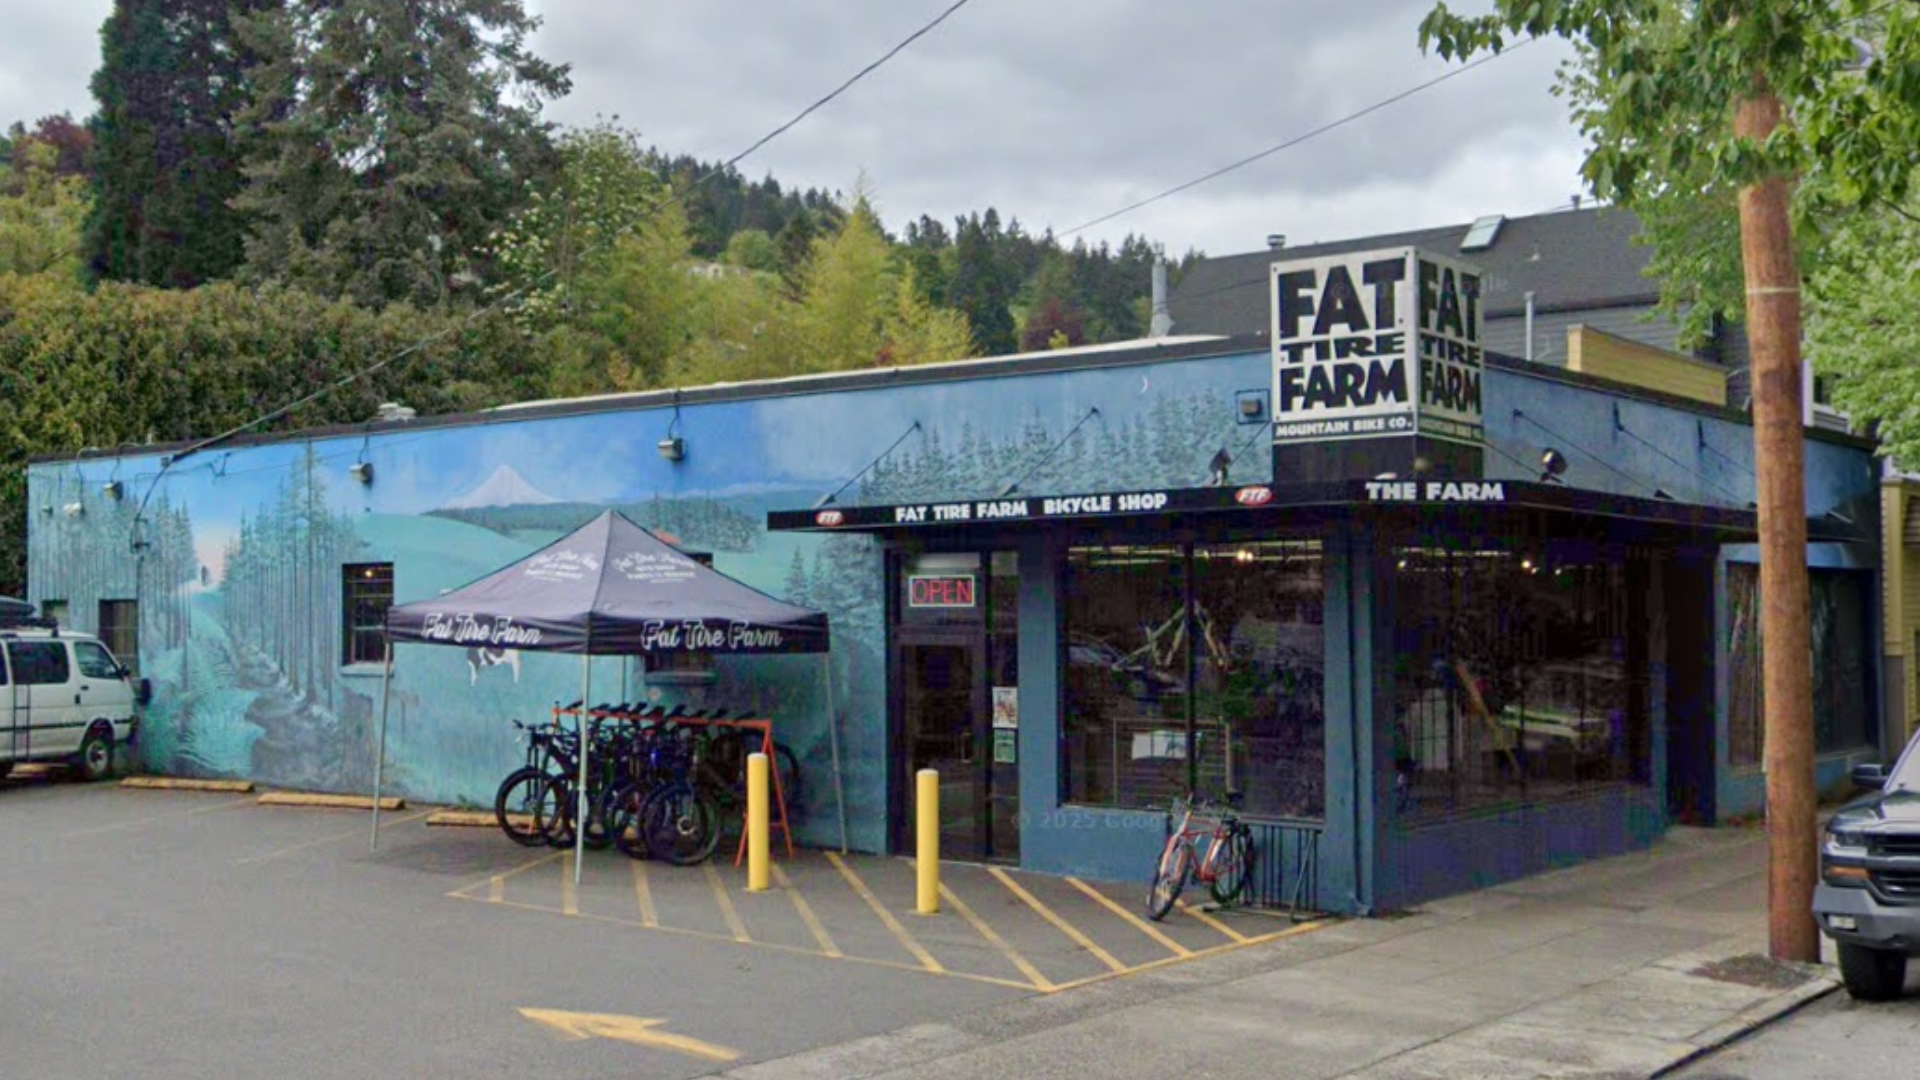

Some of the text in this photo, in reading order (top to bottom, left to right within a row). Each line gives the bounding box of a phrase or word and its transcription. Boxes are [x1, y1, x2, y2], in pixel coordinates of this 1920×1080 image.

[1278, 258, 1406, 339] FAT
[1419, 259, 1481, 342] FAT
[1280, 332, 1405, 363] TIRE
[1420, 332, 1480, 368] TIRE
[1280, 358, 1408, 412] FARM
[1420, 359, 1482, 415] FARM
[1276, 421, 1349, 436] MOUNTAIN
[1353, 418, 1384, 432] BIKE
[1388, 416, 1412, 429] CO.
[1365, 482, 1504, 500] THE FARM
[895, 493, 1167, 523] FAT TIRE FARM BICYCLE SHOP
[912, 578, 971, 605] OPEN
[421, 611, 543, 644] Fat Tire Farm
[640, 619, 783, 650] Fat Tire Farm
